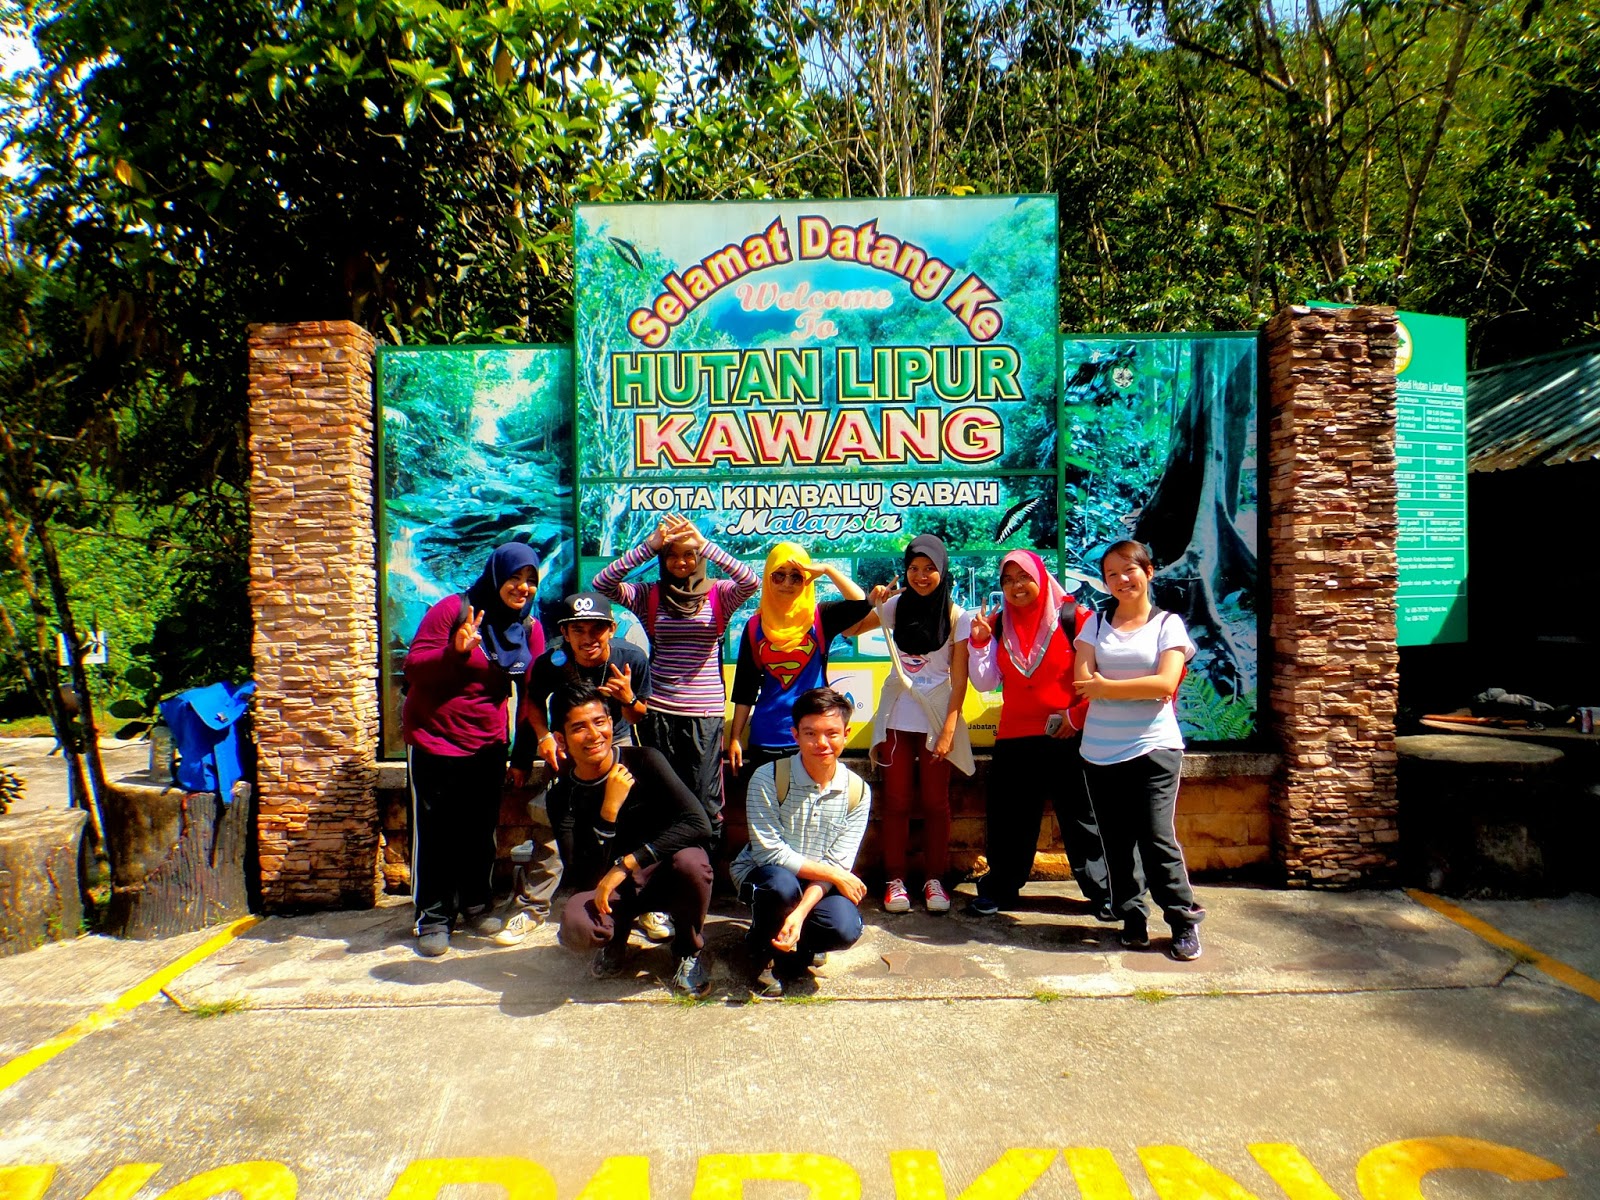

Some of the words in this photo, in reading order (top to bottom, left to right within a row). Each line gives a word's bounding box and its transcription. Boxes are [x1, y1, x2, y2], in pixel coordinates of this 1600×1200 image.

[627, 216, 793, 347] Selamat
[798, 215, 956, 302] Datang
[944, 272, 1005, 342] Ke
[735, 282, 894, 313] Welcome
[791, 310, 839, 341] To
[611, 347, 824, 407] HUTAN
[836, 345, 1025, 404] LIPUR
[633, 407, 1004, 469] KAWANG
[631, 488, 715, 511] KOTA
[723, 484, 886, 510] KINABALU
[891, 482, 999, 506] SABAH
[727, 506, 902, 538] Malaysia
